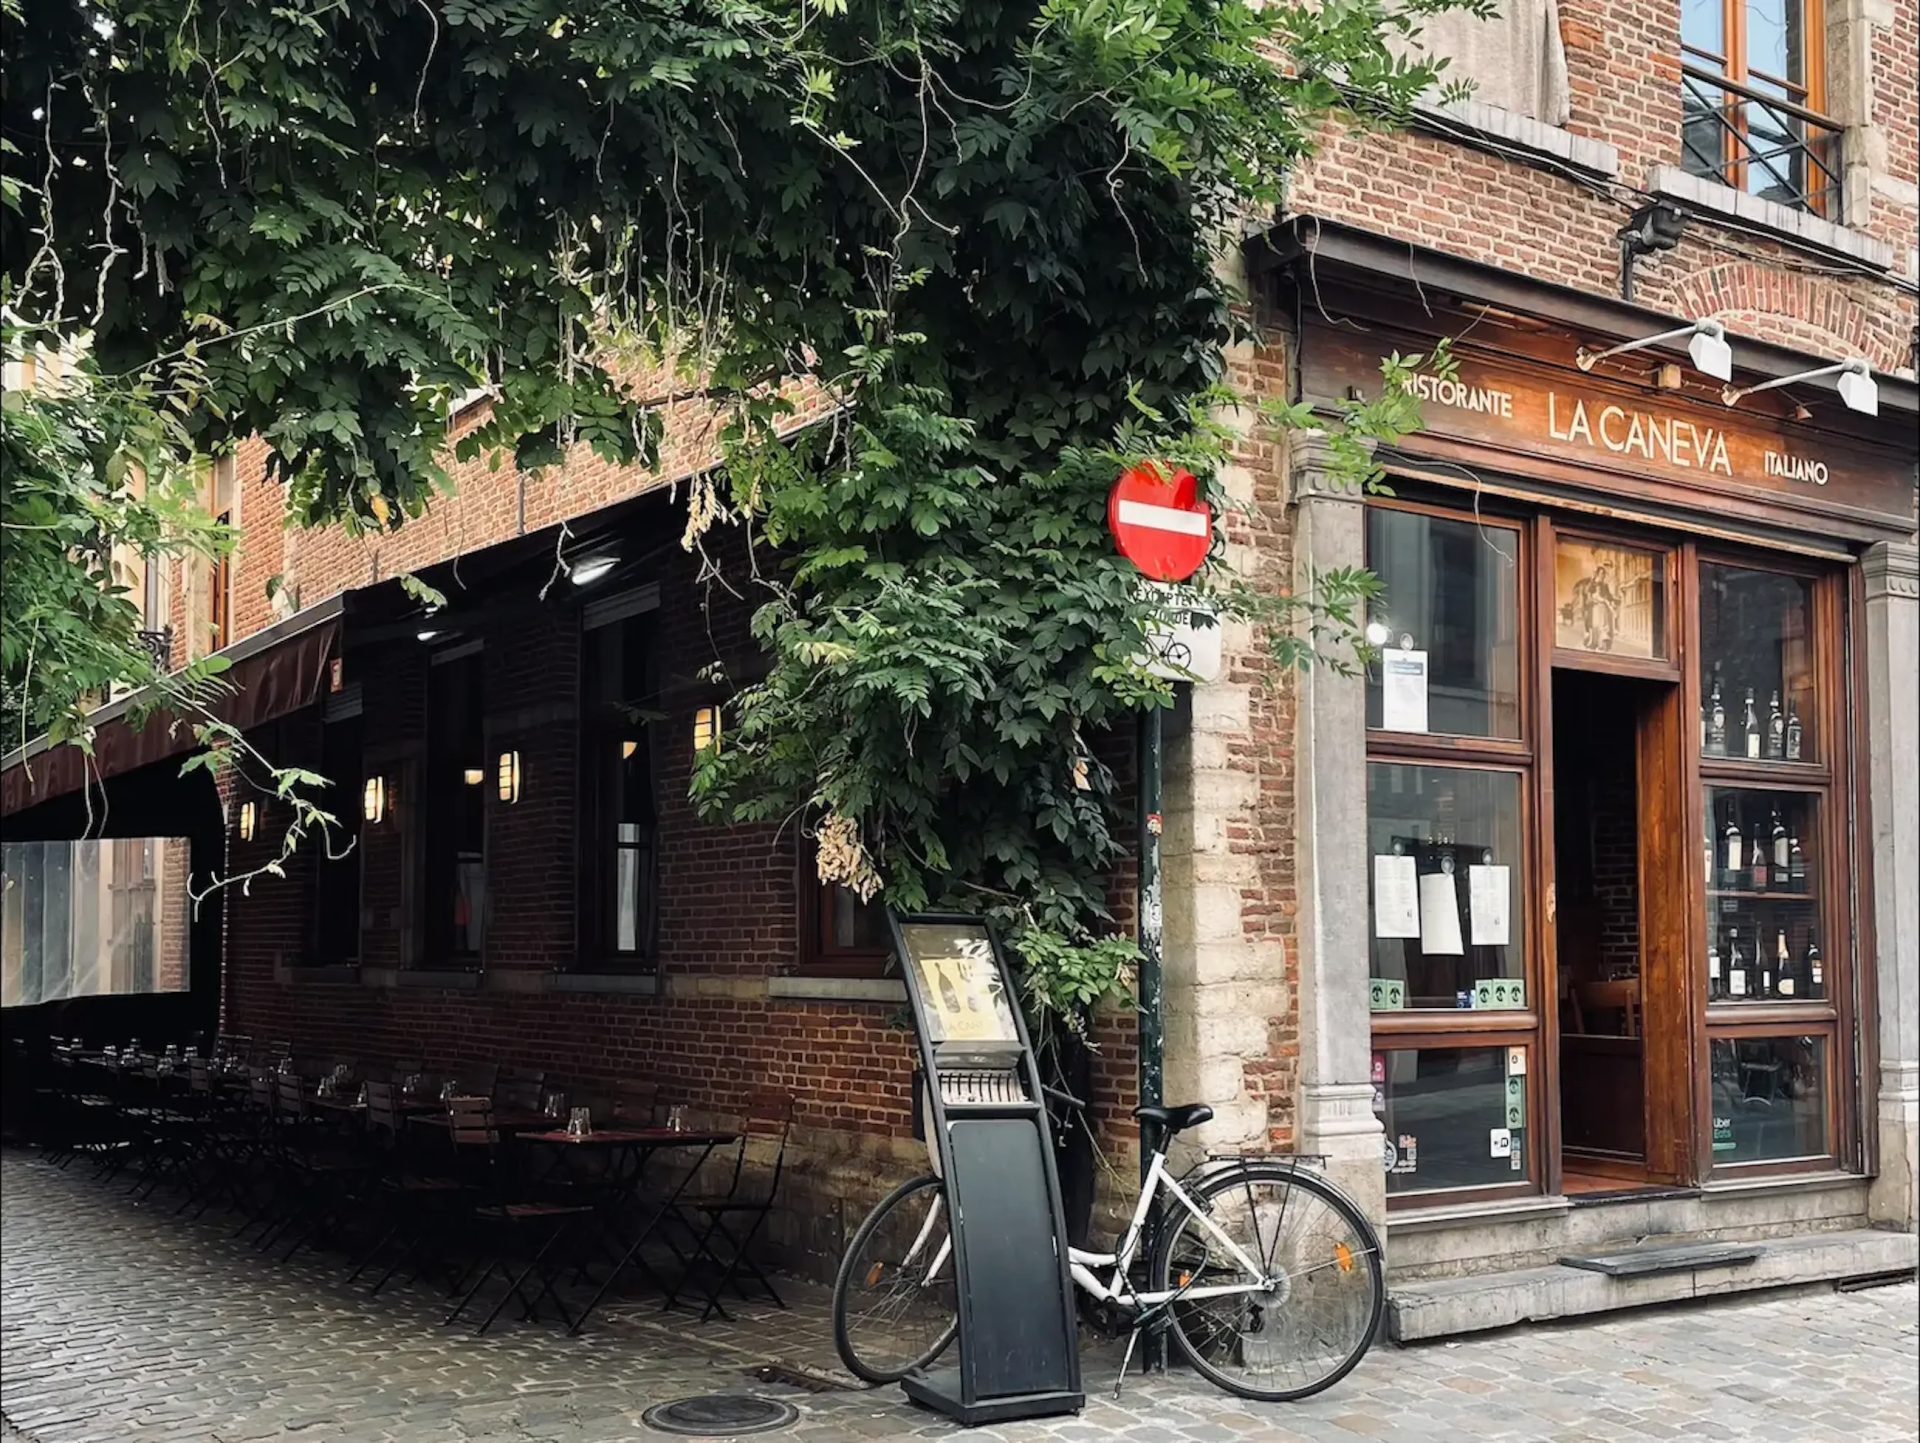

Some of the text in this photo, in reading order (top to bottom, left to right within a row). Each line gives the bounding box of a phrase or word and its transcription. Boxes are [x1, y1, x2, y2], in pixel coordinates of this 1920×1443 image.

[1401, 371, 1513, 418] RISTORANTE
[1549, 391, 1732, 476] LA CANEVA
[1764, 450, 1829, 485] ITALIANO
[1135, 588, 1190, 608] EXPTE
